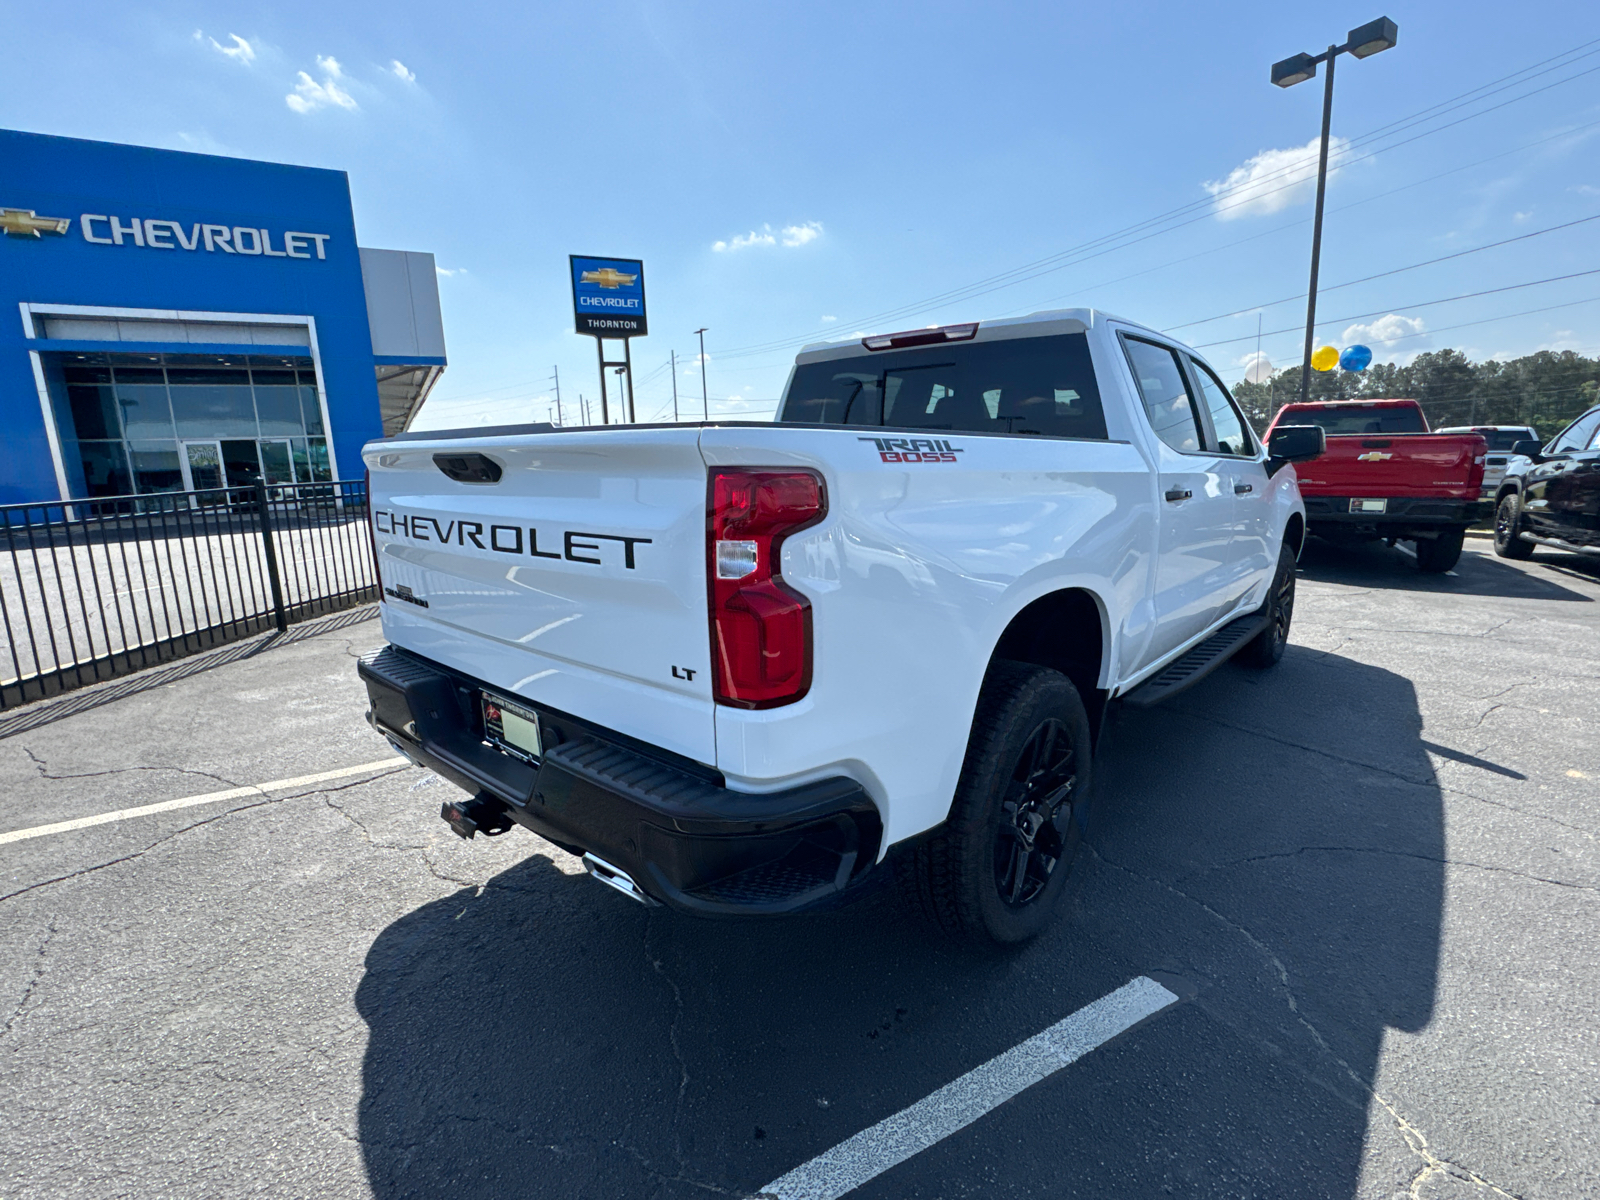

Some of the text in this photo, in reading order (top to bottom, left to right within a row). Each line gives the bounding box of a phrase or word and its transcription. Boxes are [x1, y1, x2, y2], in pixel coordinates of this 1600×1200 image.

[80, 213, 331, 260] CHEVROLET
[580, 296, 640, 308] CHEVROLET
[587, 319, 637, 329] THORNTON
[857, 437, 964, 452] TRAIL
[879, 452, 957, 462] BOSS
[375, 510, 652, 569] CHEVROLET
[671, 665, 697, 681] LT
